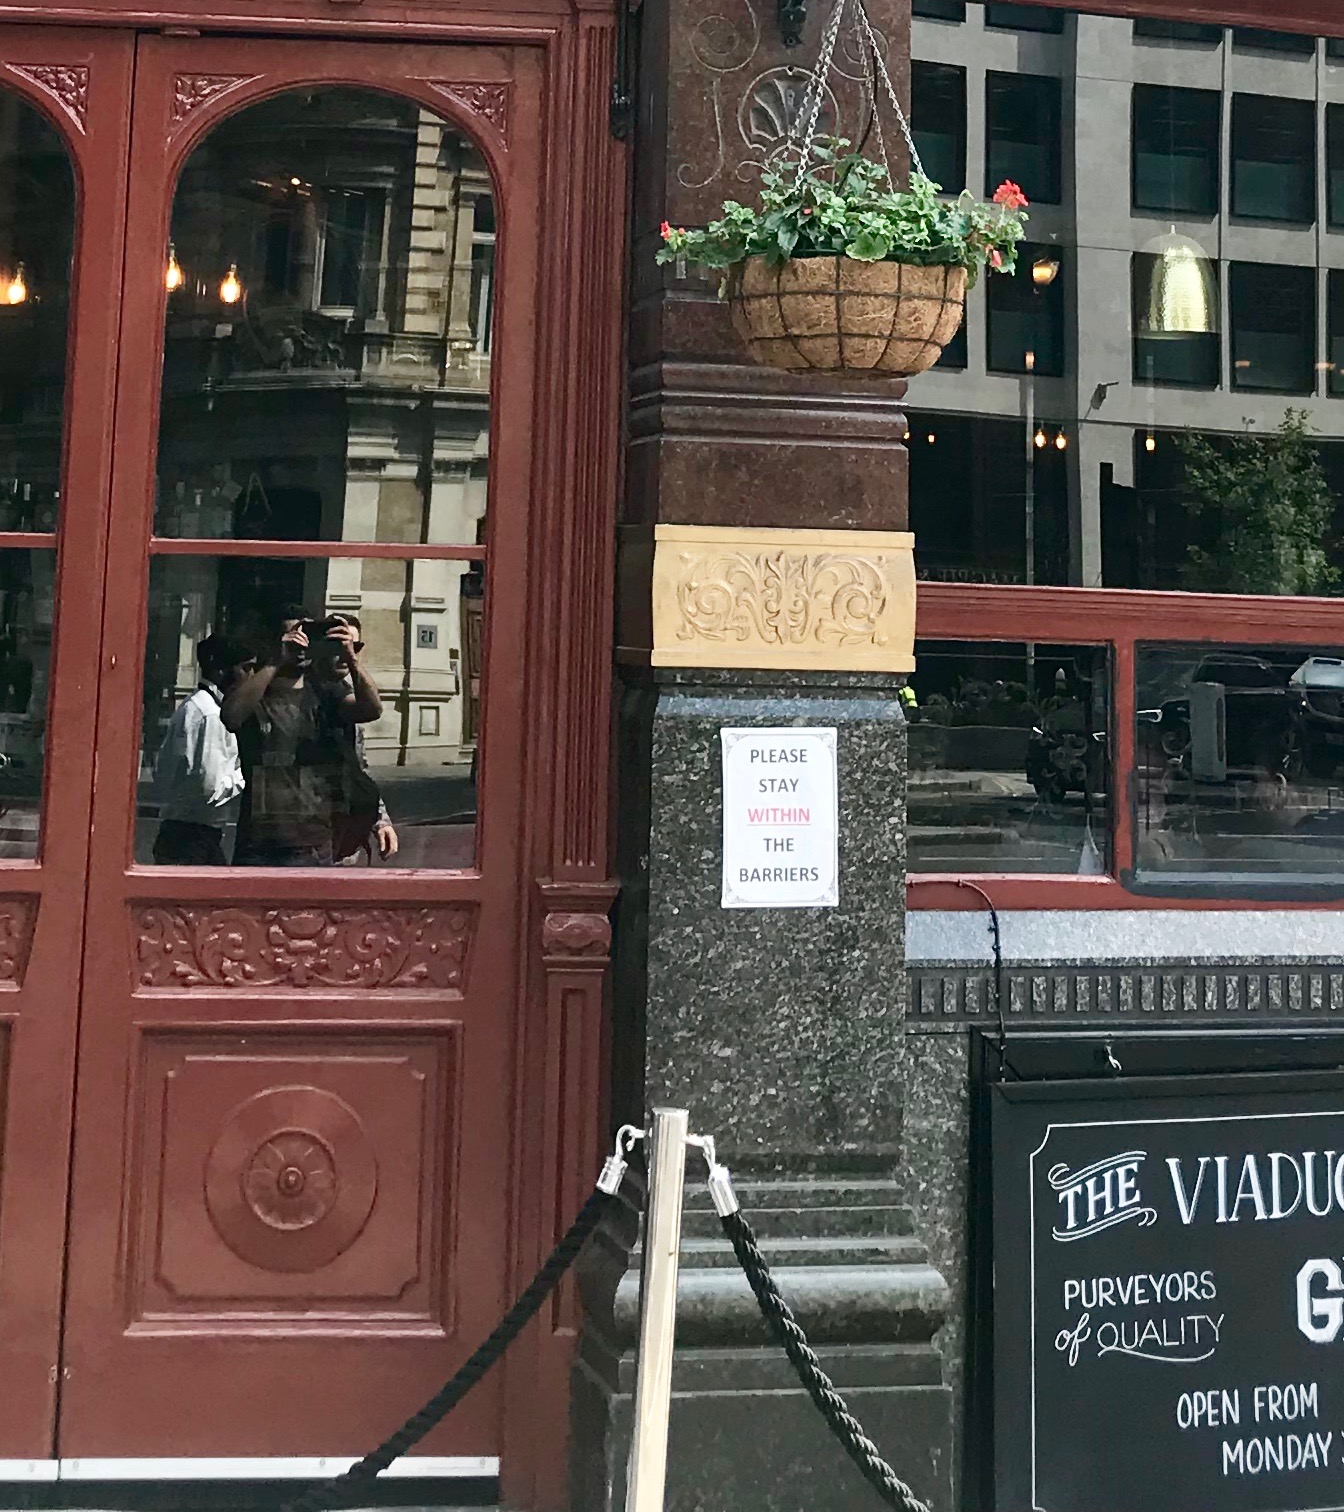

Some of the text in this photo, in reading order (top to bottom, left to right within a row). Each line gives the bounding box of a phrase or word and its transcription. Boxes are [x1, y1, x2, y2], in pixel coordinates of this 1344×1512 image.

[750, 749, 808, 763] PLEASE
[759, 778, 799, 793] STAY
[747, 808, 811, 823] WITHIN
[763, 837, 794, 852] THE
[739, 867, 819, 882] BARRIERS
[1058, 1163, 1141, 1230] THE
[1064, 1270, 1217, 1310] PURVEYORS
[1055, 1312, 1226, 1368] of QUALITY
[1176, 1387, 1241, 1428] OPEN
[1253, 1383, 1319, 1421] FROM
[1222, 1431, 1332, 1475] MONDAY
